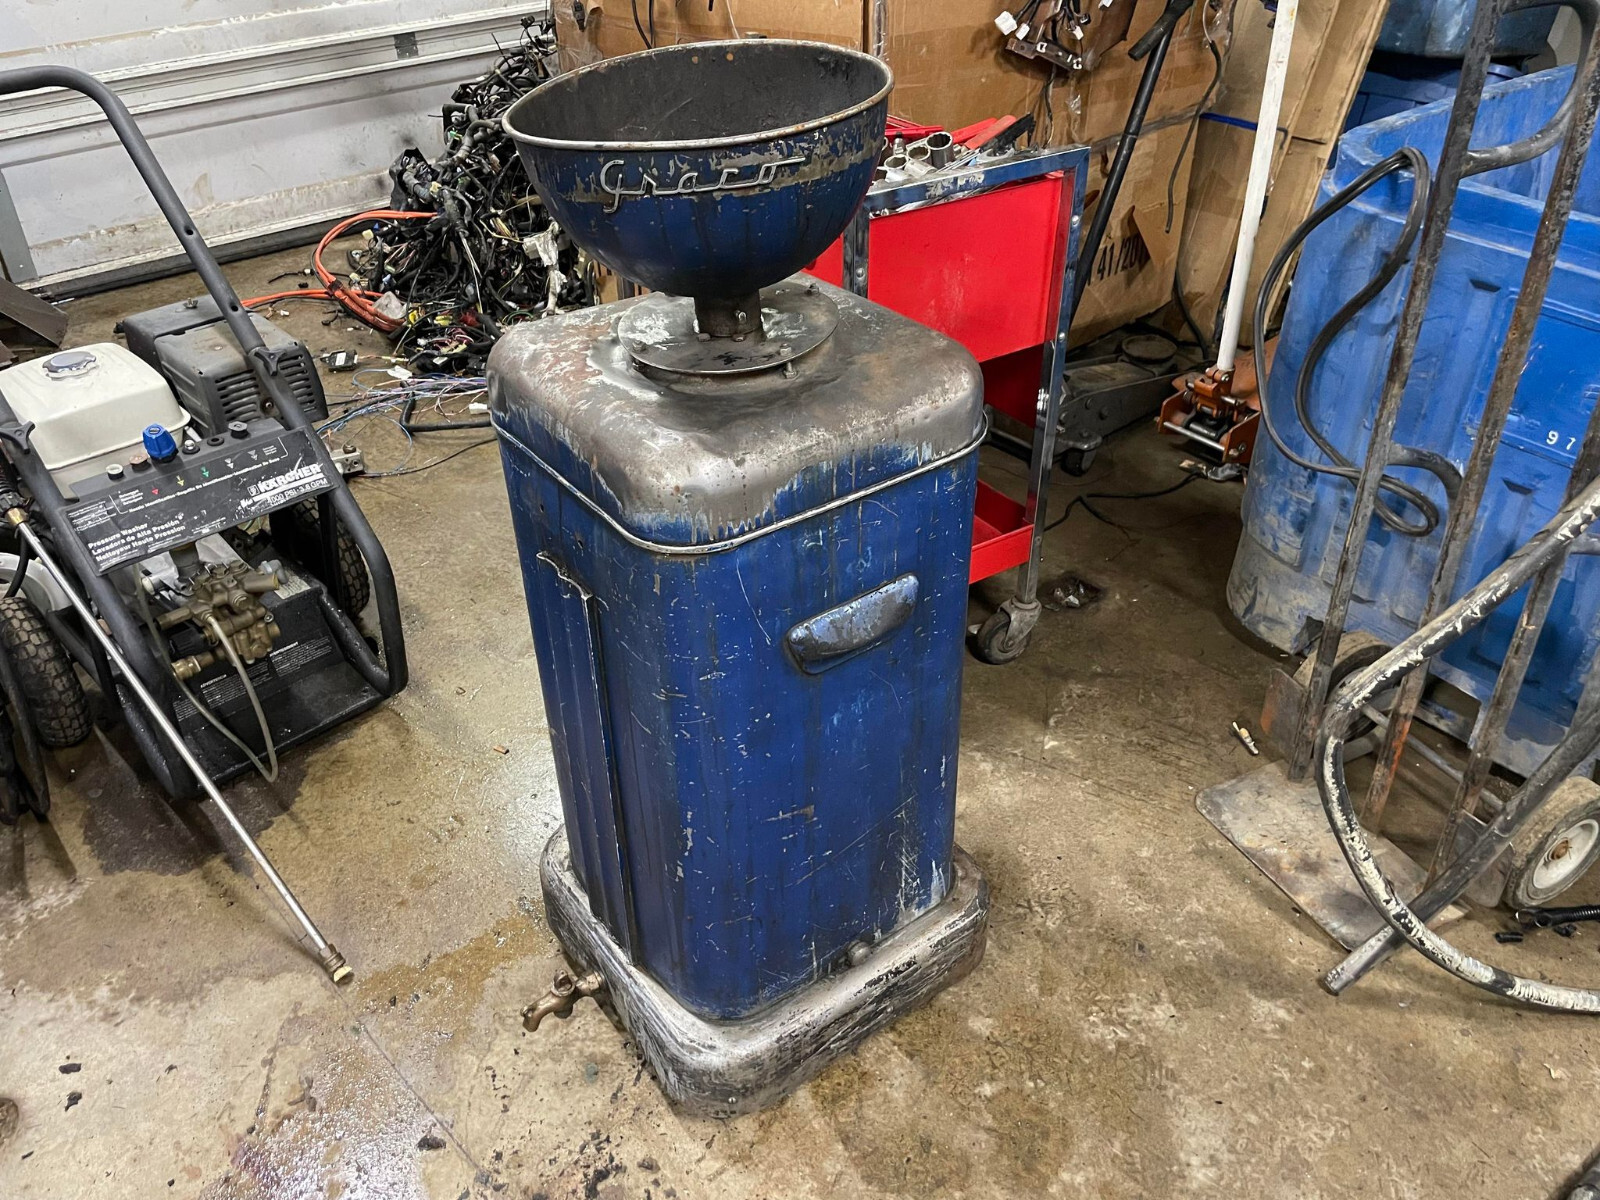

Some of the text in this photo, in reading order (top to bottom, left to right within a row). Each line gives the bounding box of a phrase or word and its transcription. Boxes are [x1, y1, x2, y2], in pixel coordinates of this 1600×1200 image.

[600, 157, 806, 213] Graco
[310, 478, 328, 488] GPM
[88, 523, 148, 549] Pressure Washer
[92, 539, 126, 556] Lavadora
[125, 535, 136, 543] de
[137, 529, 152, 539] Alta
[96, 543, 131, 562] Nettoyeur
[131, 536, 154, 548] Haute
[154, 525, 186, 540] Pression
